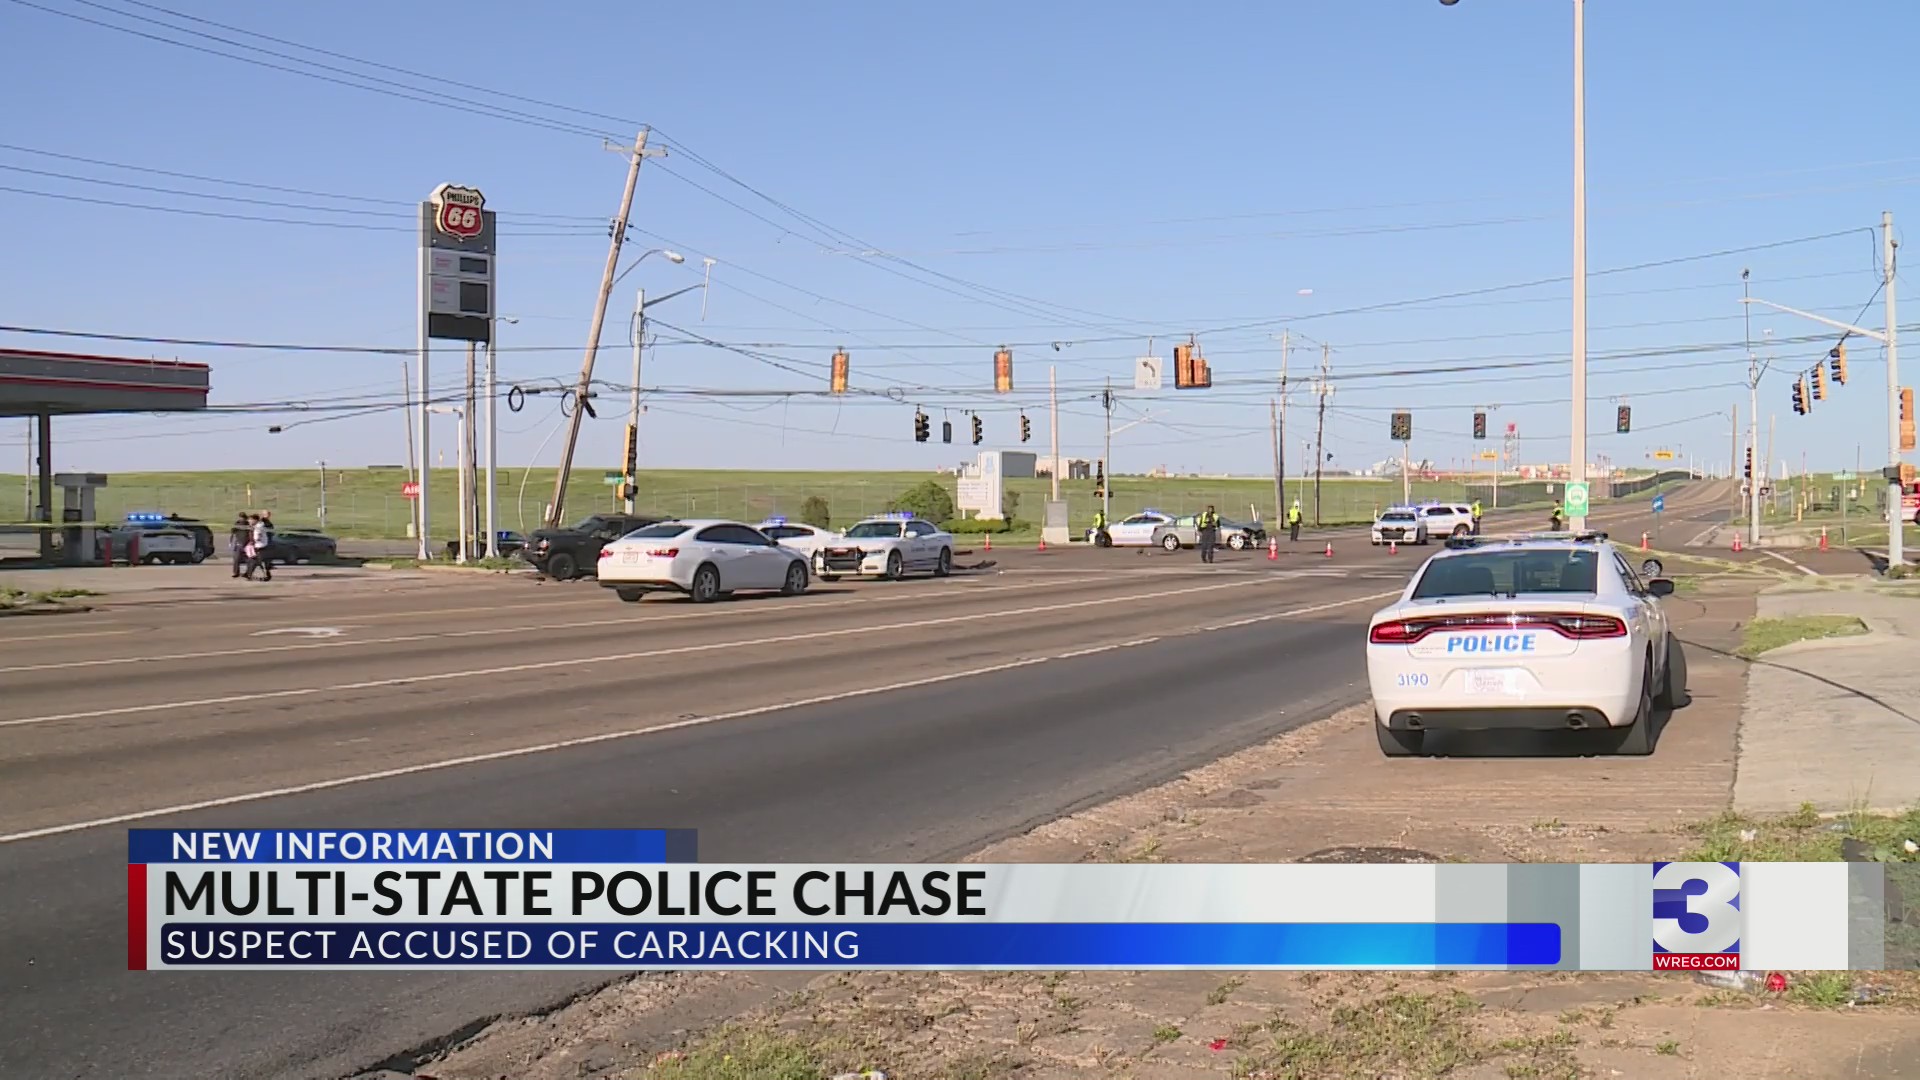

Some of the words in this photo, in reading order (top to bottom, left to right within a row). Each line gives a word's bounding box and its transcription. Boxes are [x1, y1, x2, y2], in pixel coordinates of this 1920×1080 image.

[446, 191, 480, 206] PHILLIPS
[447, 206, 477, 228] 66
[1446, 633, 1537, 653] POLICE
[1398, 673, 1430, 687] 3190
